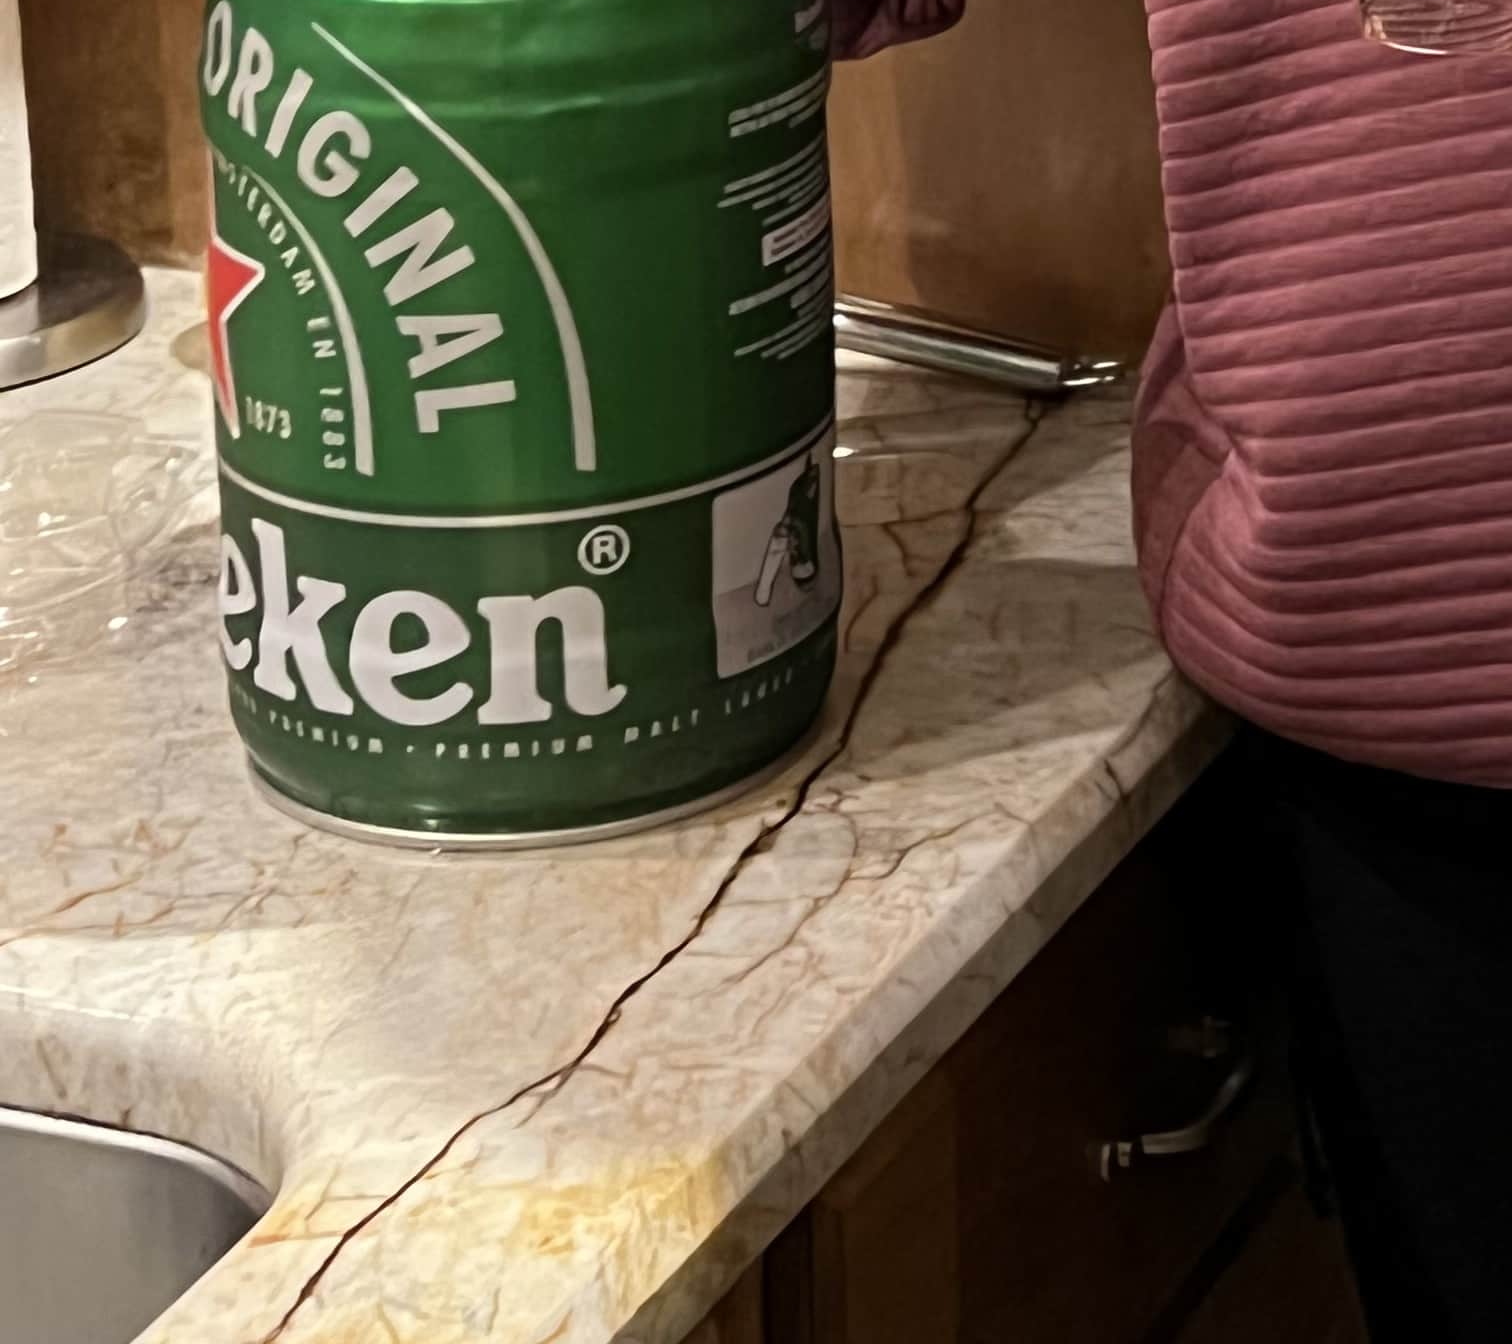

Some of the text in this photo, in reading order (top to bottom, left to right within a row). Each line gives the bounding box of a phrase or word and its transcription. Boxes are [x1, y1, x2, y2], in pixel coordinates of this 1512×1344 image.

[203, 0, 518, 434] ORIGINAL
[306, 315, 337, 358] IN
[245, 395, 292, 440] 1873
